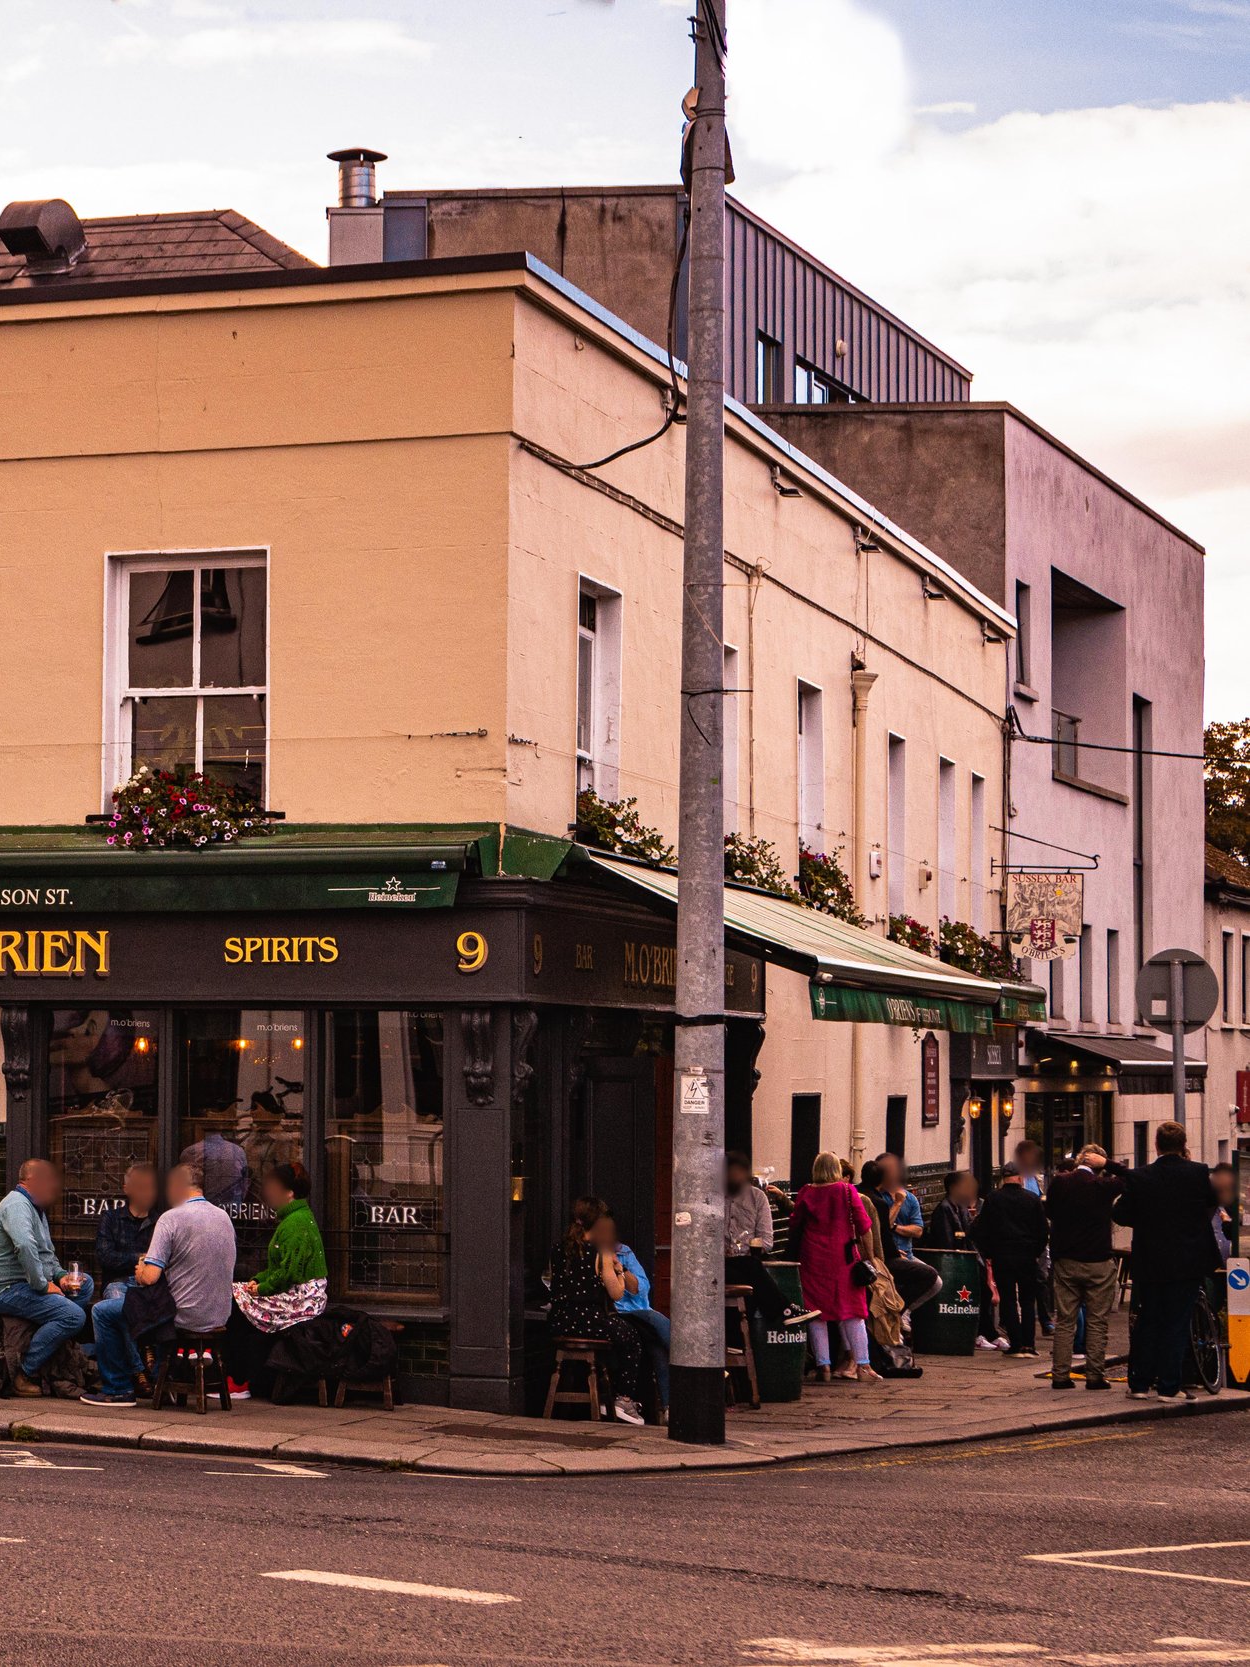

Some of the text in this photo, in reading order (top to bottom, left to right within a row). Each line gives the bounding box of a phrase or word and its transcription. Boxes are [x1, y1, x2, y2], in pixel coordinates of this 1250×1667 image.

[1012, 874, 1077, 883] SUSSEX BAR
[45, 888, 74, 905] ST.
[368, 892, 416, 902] Heineken
[224, 936, 339, 963] SPIRITS
[456, 931, 488, 972] 9
[533, 934, 543, 974] 9
[575, 944, 594, 969] BAR
[624, 942, 677, 986] M.O'BRI
[751, 963, 757, 992] 9
[110, 1019, 151, 1028] m.o'briens
[256, 1023, 298, 1032] m.o'briens
[370, 1206, 418, 1224] BAR
